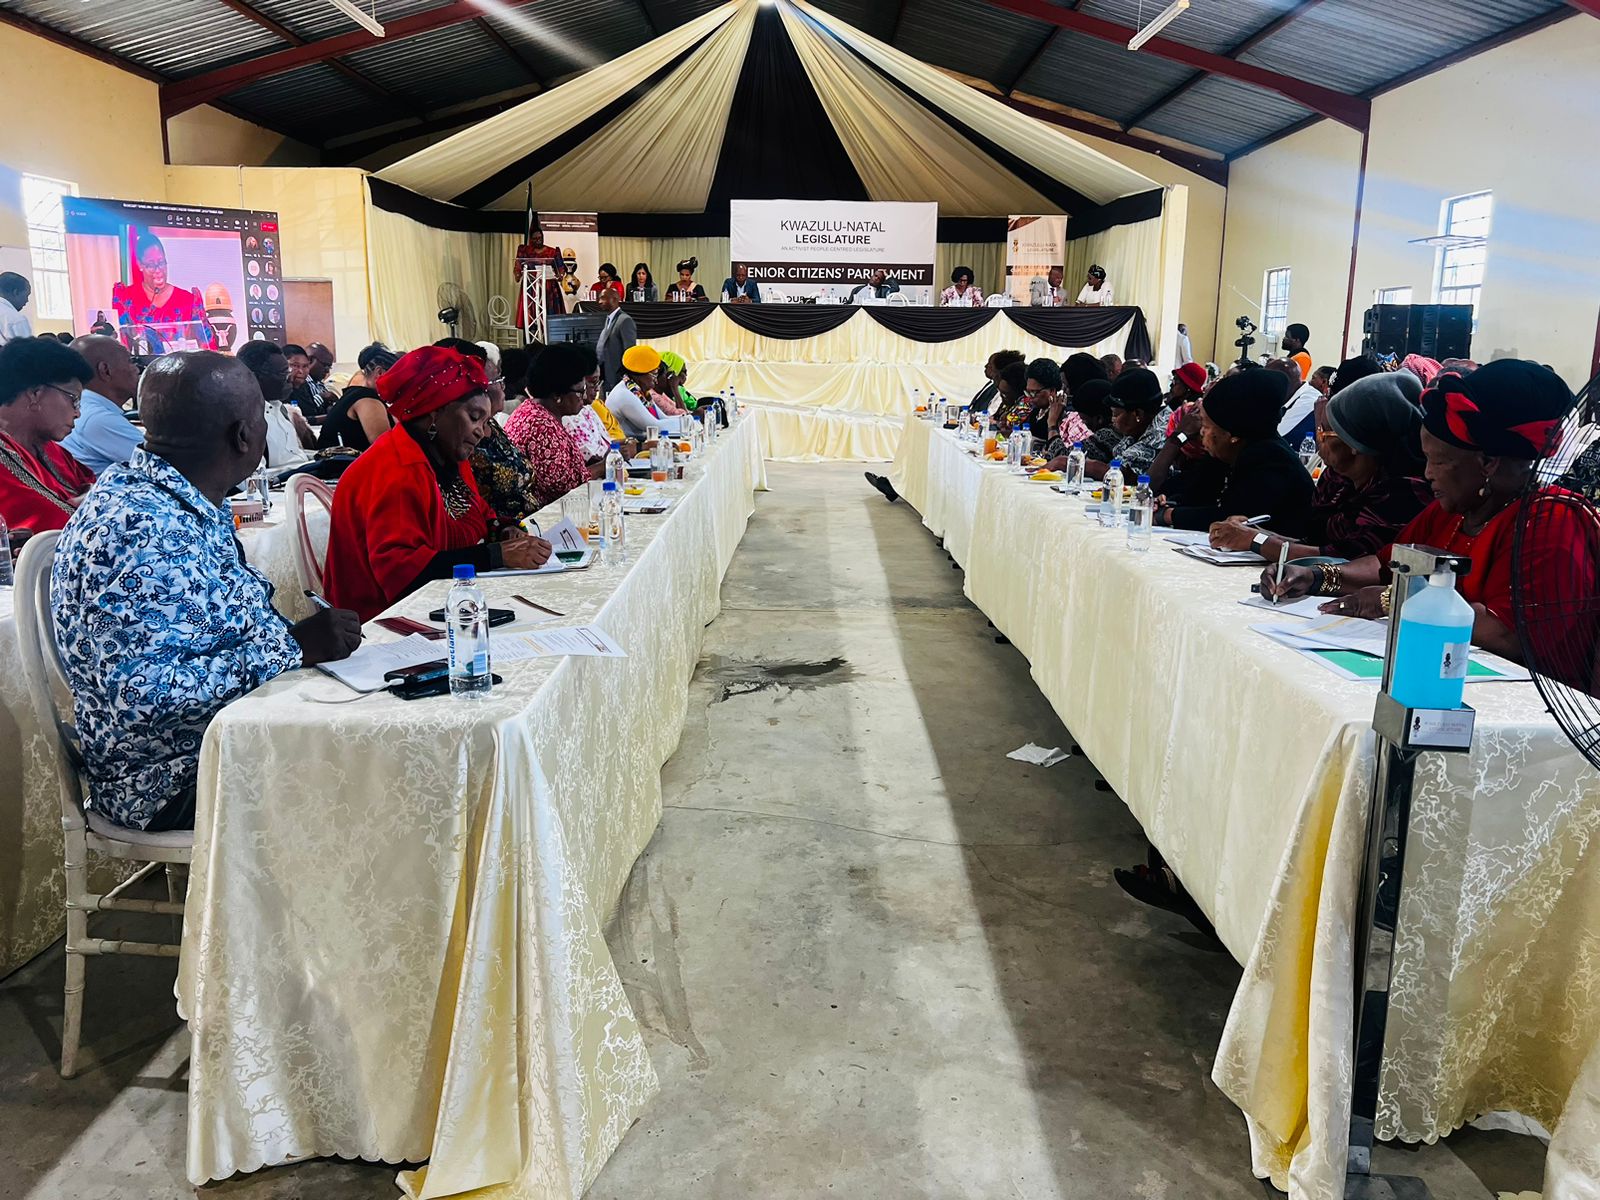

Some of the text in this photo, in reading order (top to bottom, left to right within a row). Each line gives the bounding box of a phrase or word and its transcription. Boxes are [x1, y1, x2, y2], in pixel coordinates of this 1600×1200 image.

[780, 220, 886, 233] KWAZULU-NATAL
[795, 234, 871, 244] LEGISLATURE
[747, 267, 785, 278] ENIOR
[848, 268, 926, 280] PARMENT
